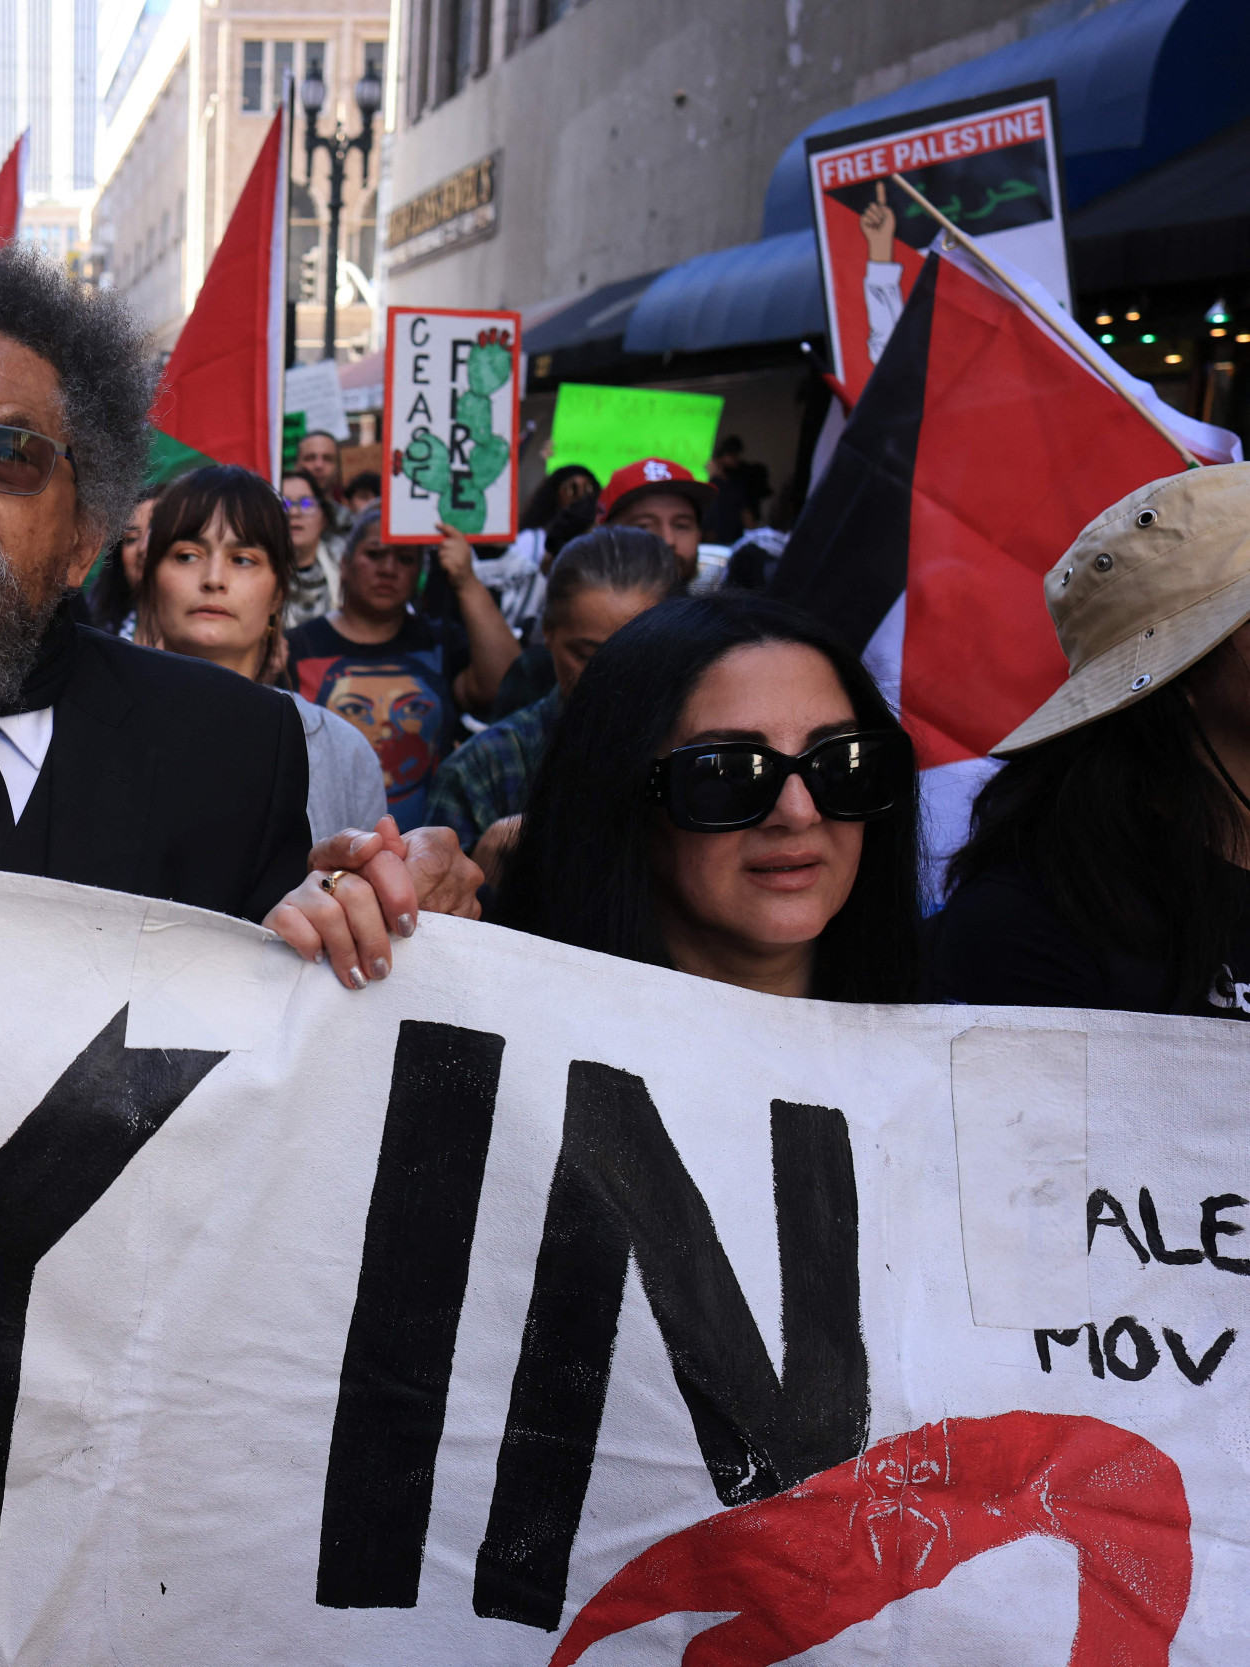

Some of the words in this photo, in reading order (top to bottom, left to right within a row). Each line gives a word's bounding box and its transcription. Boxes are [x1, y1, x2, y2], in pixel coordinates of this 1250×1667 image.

[821, 148, 888, 186] FREE
[893, 110, 1042, 169] PALESTINE
[406, 317, 433, 500] CEASE
[451, 339, 476, 510] FIRE
[316, 1020, 871, 1632] IN
